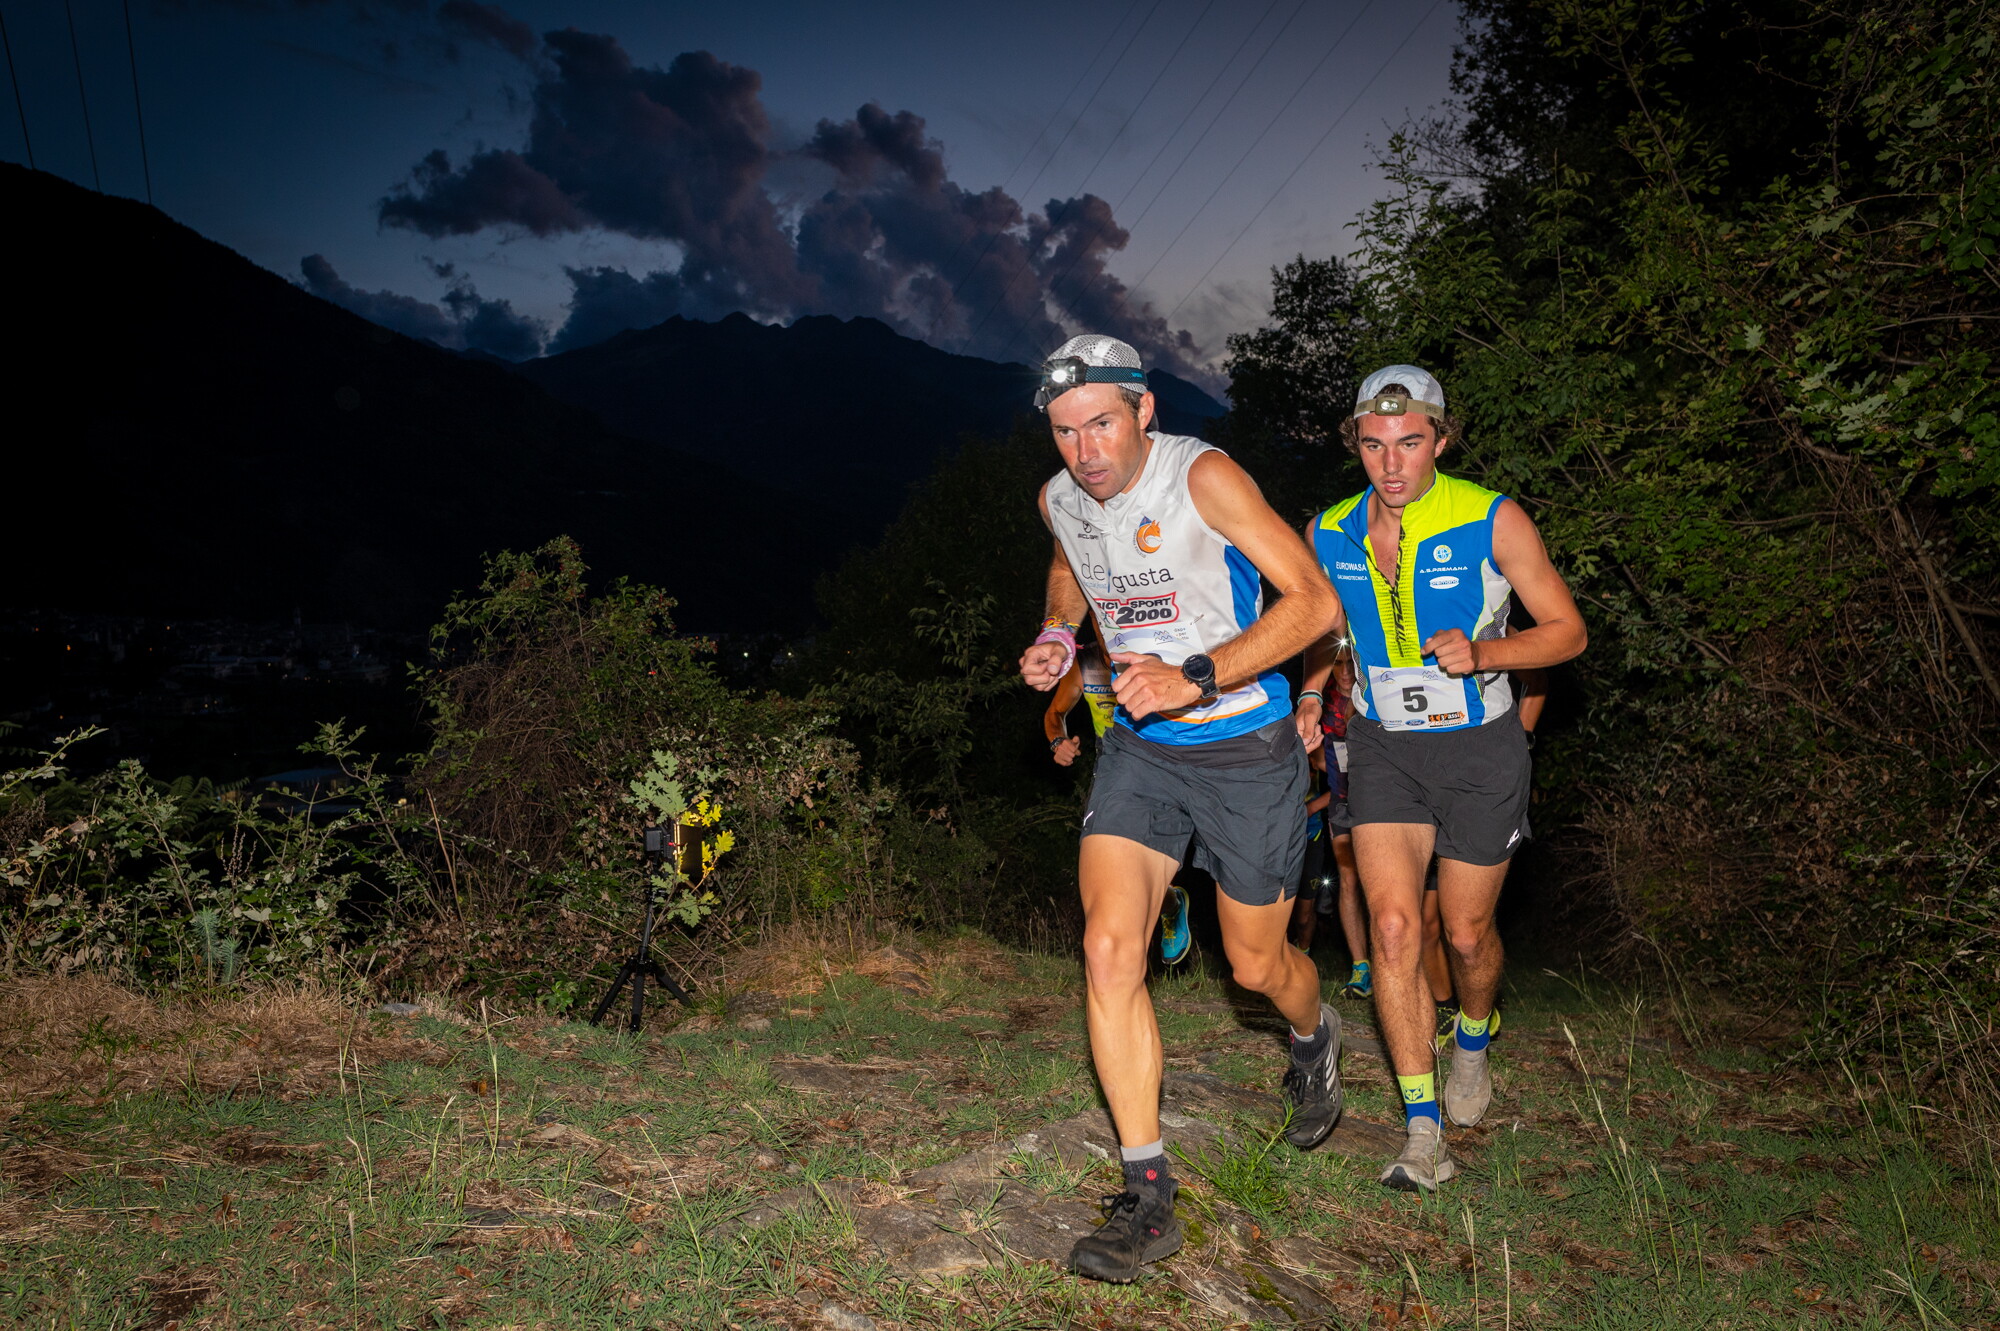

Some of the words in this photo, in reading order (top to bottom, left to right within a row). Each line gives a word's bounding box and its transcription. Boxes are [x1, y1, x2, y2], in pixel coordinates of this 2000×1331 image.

[1081, 552, 1106, 581] de
[1111, 568, 1175, 593] gusta
[1335, 560, 1368, 572] EUROWASA
[1130, 597, 1171, 609] SPORT
[1115, 606, 1172, 625] 2000
[1402, 685, 1428, 713] 5
